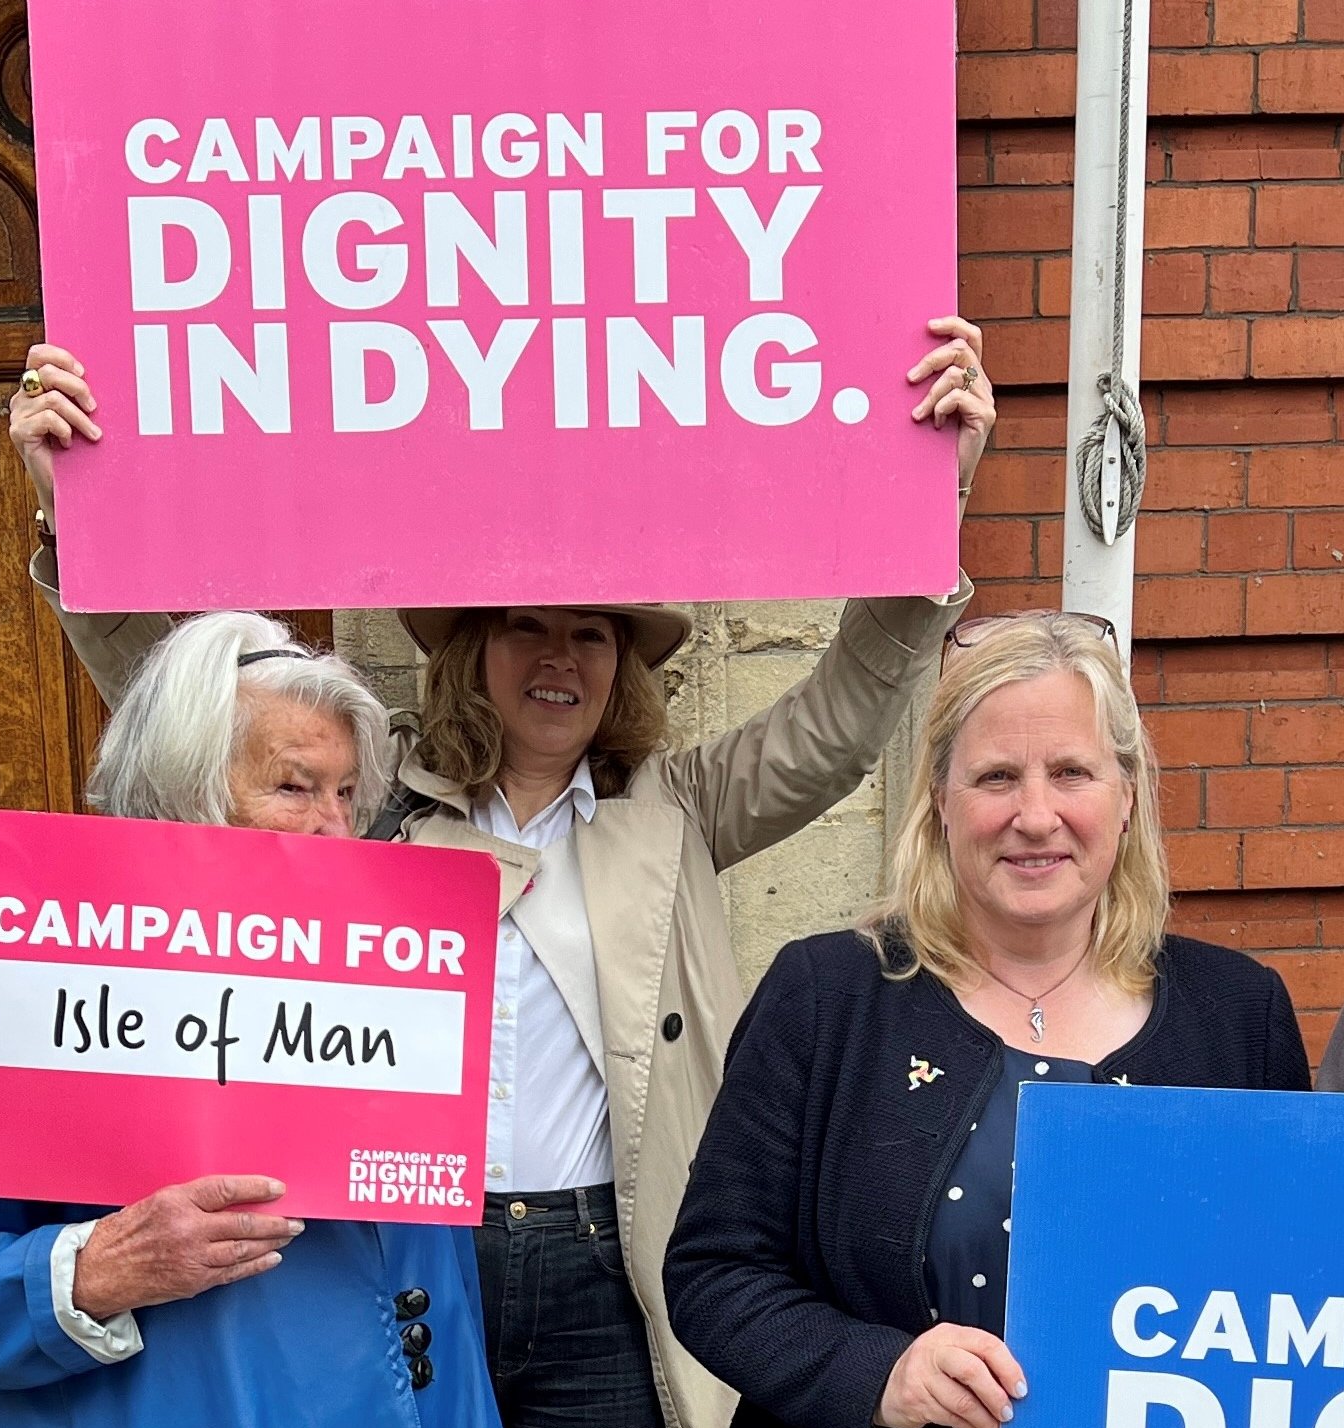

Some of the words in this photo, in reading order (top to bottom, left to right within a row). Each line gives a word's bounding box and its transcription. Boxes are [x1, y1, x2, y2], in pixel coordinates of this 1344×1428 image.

[124, 112, 604, 184] CAMPAIGN
[646, 109, 823, 176] FOR
[127, 185, 823, 312] DIGNITY
[133, 322, 292, 436] IN
[329, 312, 870, 433] DYING.
[345, 922, 467, 976] FOR
[52, 983, 145, 1054] Isle
[174, 986, 240, 1087] of
[262, 1000, 397, 1068] Man
[349, 1161, 467, 1187] DIGNITY
[350, 1149, 431, 1165] CAMPAIGN
[437, 1154, 468, 1167] FOR
[348, 1182, 377, 1203] IN
[380, 1183, 473, 1207] DYING.
